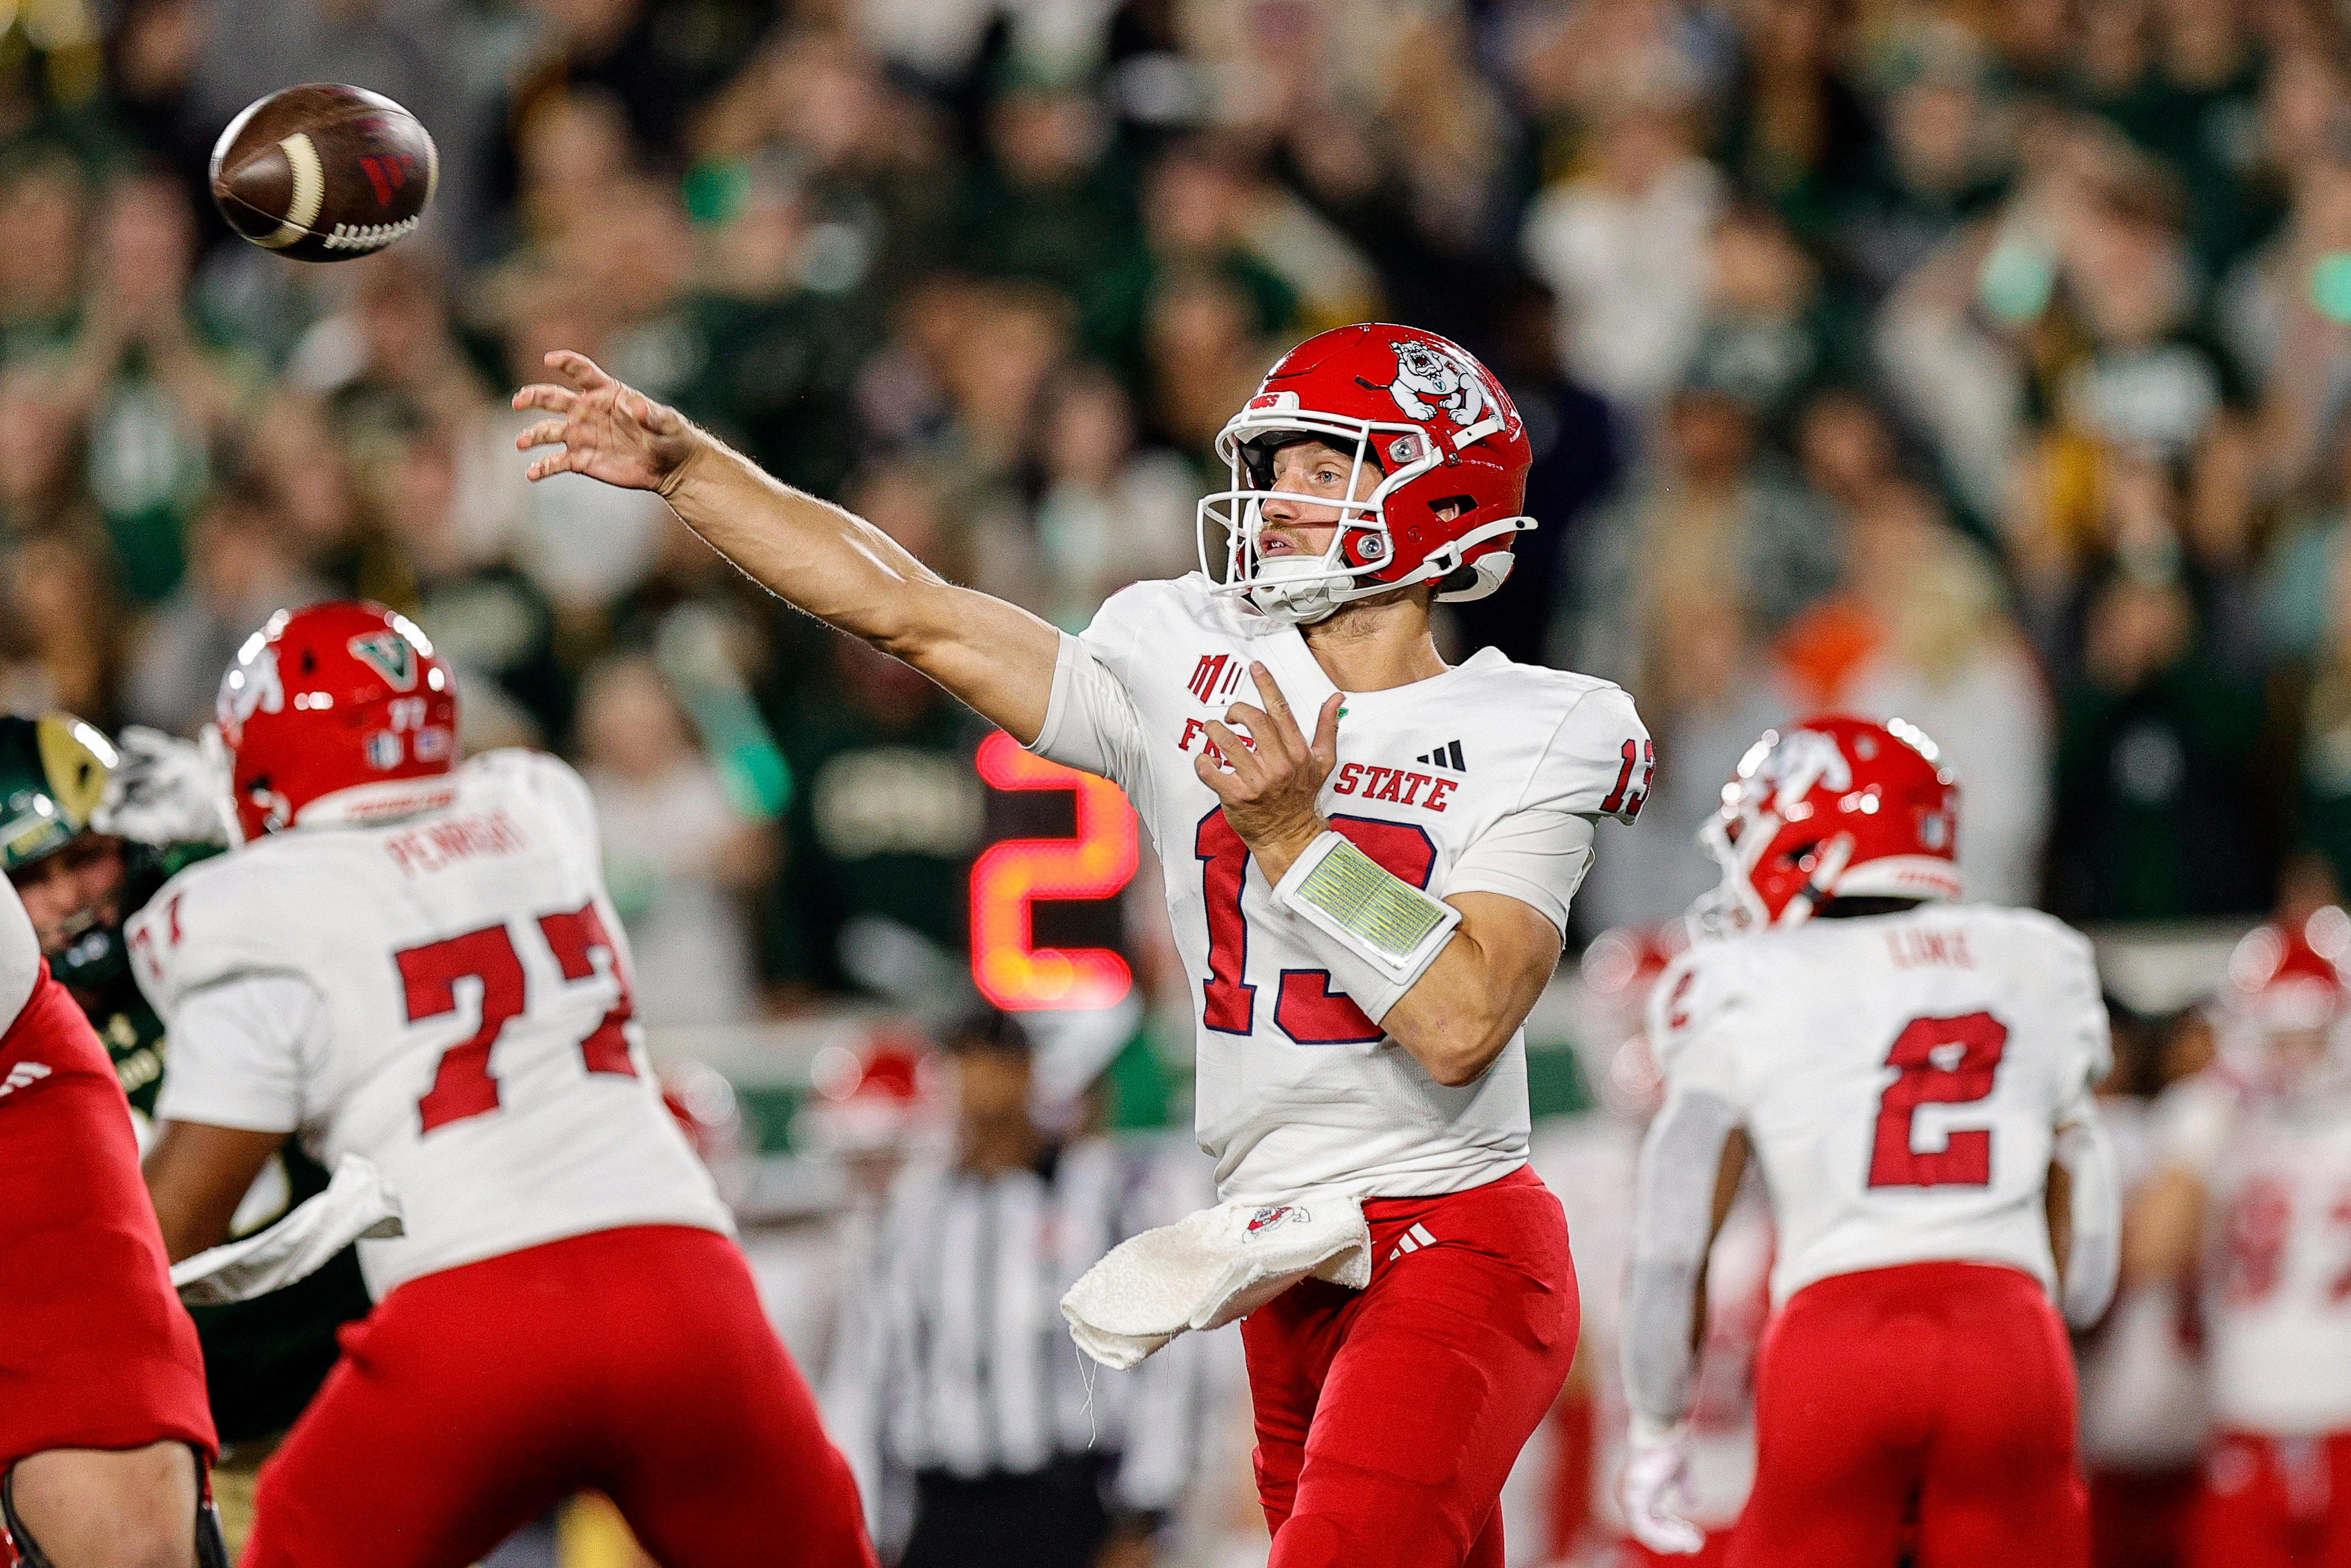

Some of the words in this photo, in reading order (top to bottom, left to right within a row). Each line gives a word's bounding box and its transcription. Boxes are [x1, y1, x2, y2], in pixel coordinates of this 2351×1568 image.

[970, 729, 1139, 1011] 2
[1333, 762, 1459, 812] STATE
[394, 899, 639, 1136] 77
[1868, 1010, 2008, 1189] 2
